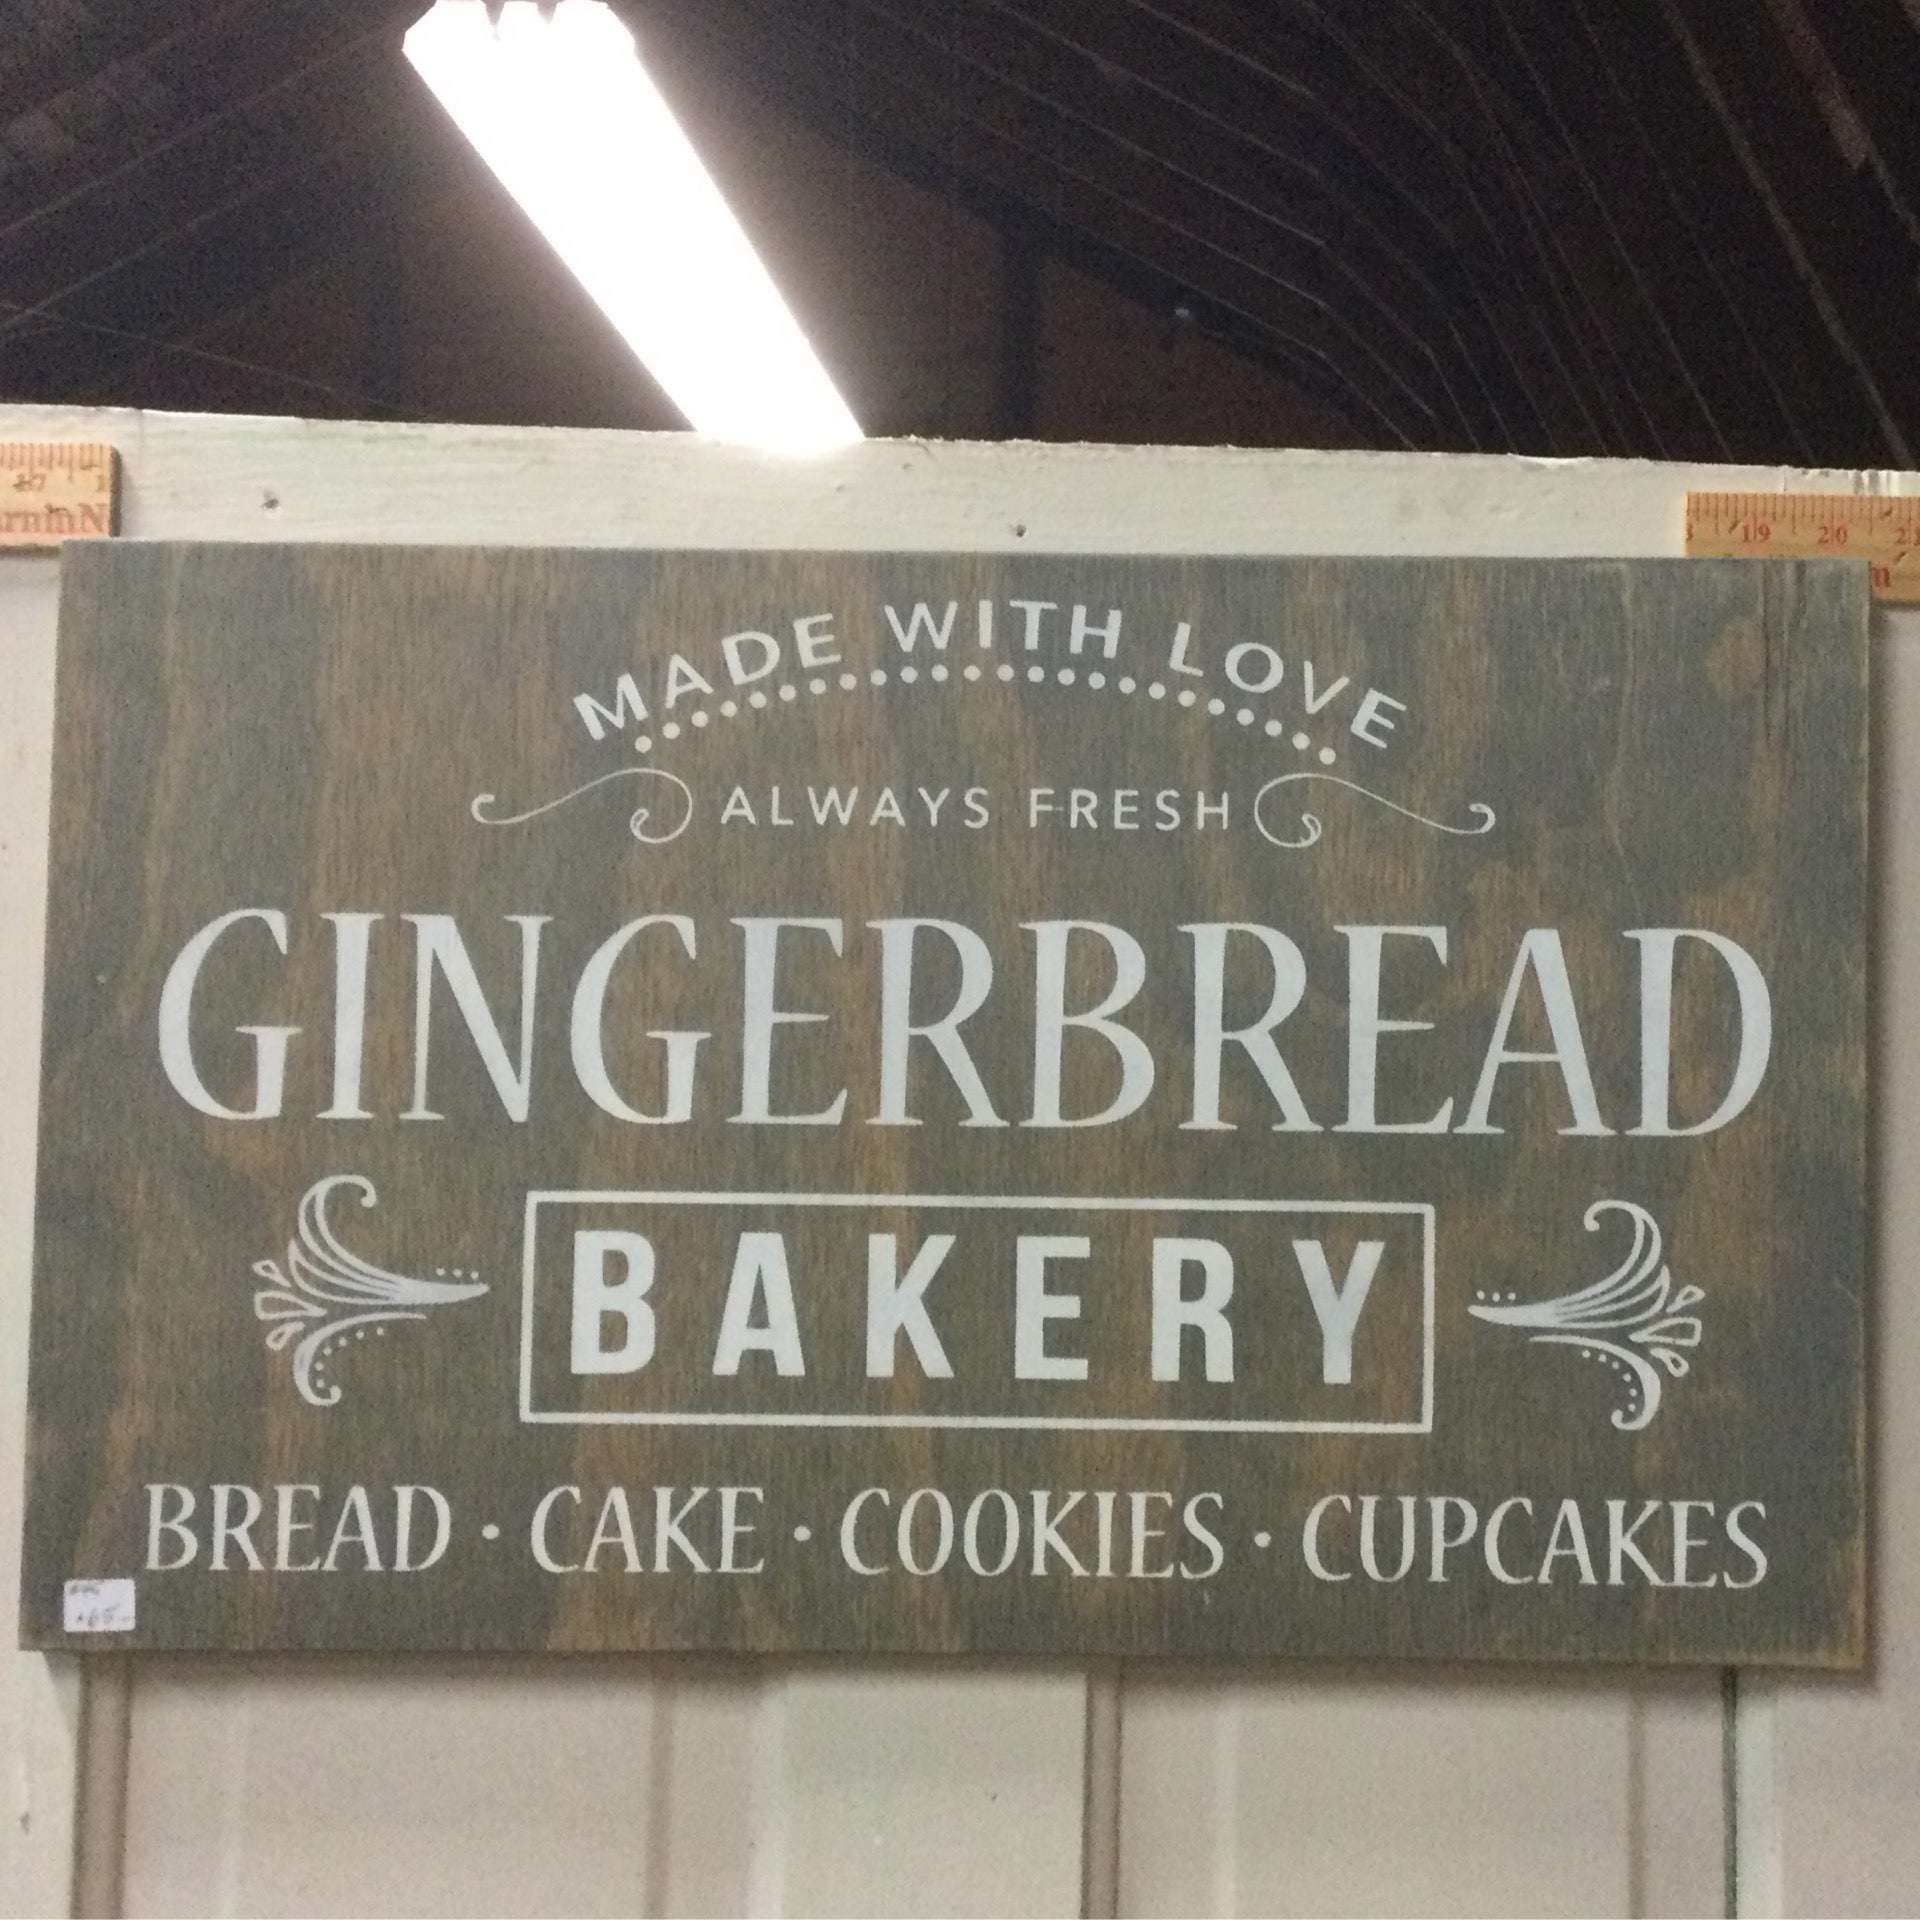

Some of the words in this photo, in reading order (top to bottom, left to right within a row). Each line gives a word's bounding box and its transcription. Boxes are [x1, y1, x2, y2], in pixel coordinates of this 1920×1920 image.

[1741, 523, 1771, 543] 19
[1818, 526, 1849, 545] 20
[572, 612, 842, 741] MADE
[883, 599, 1122, 659] WITH
[1169, 622, 1407, 749] LOVE
[719, 785, 990, 829] ALWAYS
[1029, 788, 1230, 831] FRESH
[158, 907, 1773, 1138] GINGERBREAD
[570, 1229, 1385, 1384] BAKERY
[145, 1484, 453, 1573] BREAD
[530, 1486, 765, 1574] CAKE
[839, 1488, 1225, 1579] COOKIES
[1301, 1495, 1769, 1590] CUPCAKES
